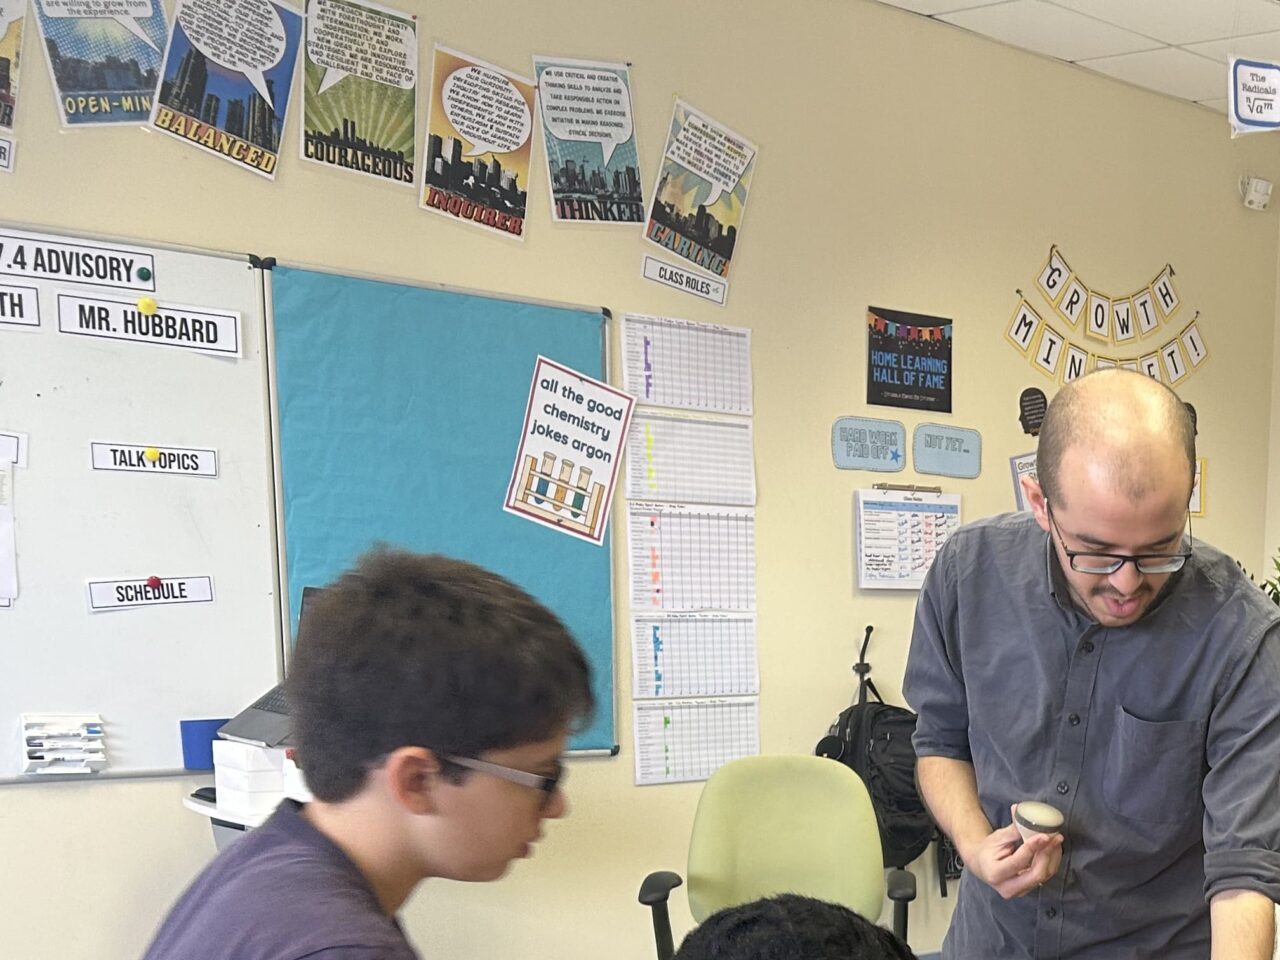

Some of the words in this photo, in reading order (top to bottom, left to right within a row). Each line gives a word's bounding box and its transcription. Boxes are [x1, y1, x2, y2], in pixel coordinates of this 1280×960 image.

[320, 8, 336, 16] WITH
[388, 27, 400, 35] AND
[330, 4, 363, 16] APPROACH
[366, 13, 407, 30] UNCERTAINTY
[334, 41, 352, 50] IDEAS
[355, 47, 368, 55] AND
[361, 70, 373, 78] AND
[466, 73, 479, 81] OUR
[471, 67, 481, 75] WE
[1250, 73, 1266, 82] The
[481, 93, 494, 101] AND
[1242, 83, 1276, 95] Radicals
[66, 94, 151, 115] OPEN-MIN
[155, 107, 276, 174] BALANCED
[304, 138, 413, 184] COURAGEOUS
[426, 187, 523, 235] INQUIRER
[556, 200, 644, 222] THINKER
[651, 222, 727, 276] CARING
[33, 247, 134, 283] ADVISORY
[658, 266, 684, 287] CLASS
[684, 275, 711, 295] ROLES
[1046, 267, 1174, 335] GROWTH
[78, 304, 117, 333] MR.
[123, 309, 218, 344] HUBBARD
[1014, 313, 1201, 380] MINET!
[871, 351, 898, 368] HOME
[900, 355, 947, 374] LEARNING
[873, 367, 900, 385] HALL
[903, 371, 916, 386] OF
[919, 372, 945, 390] FAME
[540, 377, 558, 394] all
[562, 385, 584, 405] the
[587, 398, 623, 420] good
[544, 403, 610, 441] chemistry
[531, 419, 568, 446] jokes
[571, 438, 612, 463] argon
[839, 427, 867, 443] HARD
[869, 429, 898, 446] WORK
[924, 433, 942, 448] NOT
[110, 449, 146, 467] TALK
[846, 443, 869, 458] PAID
[871, 444, 889, 460] OFF
[116, 582, 187, 602] SCHEDULE
